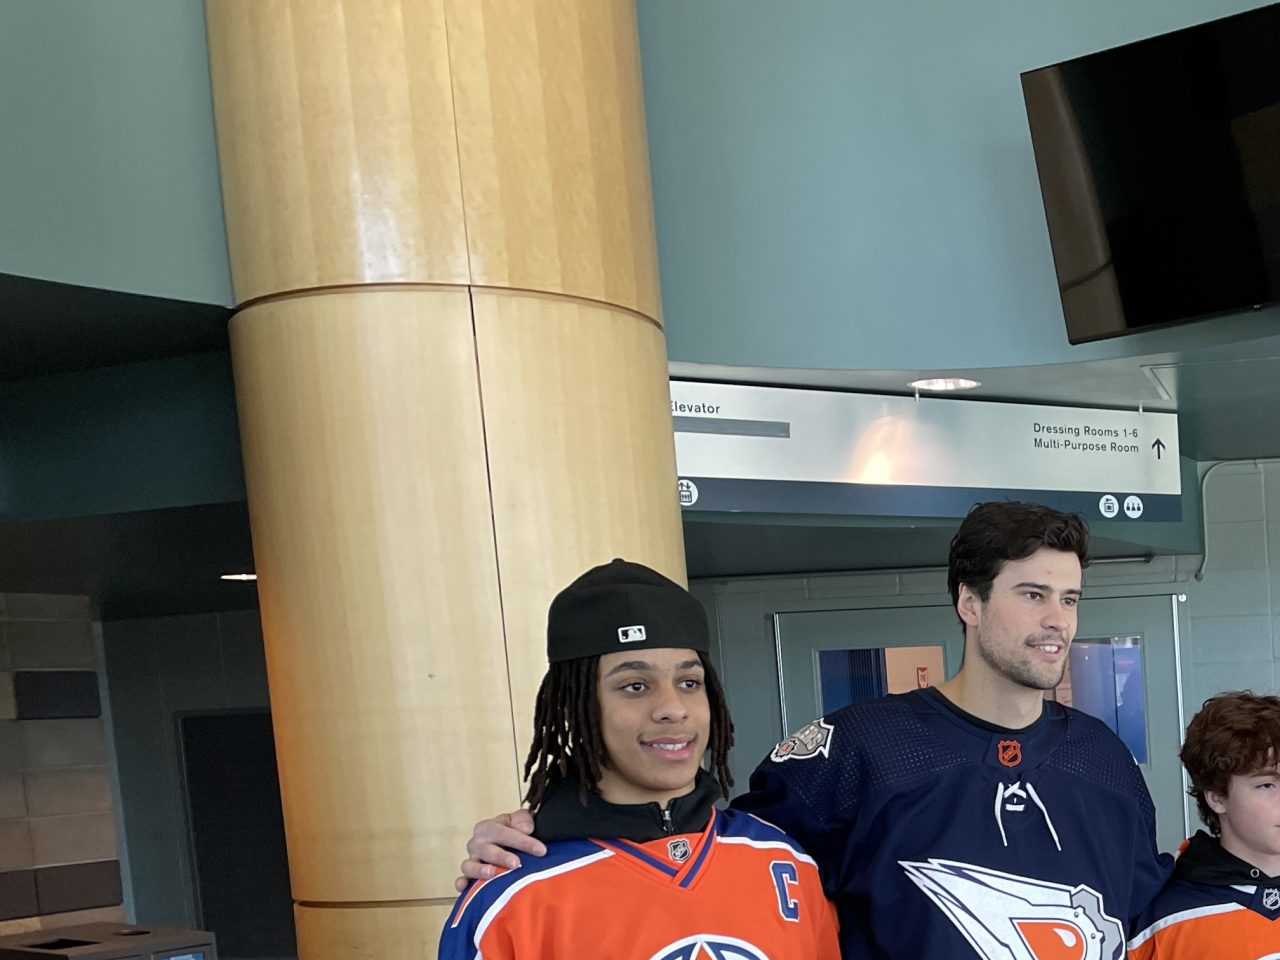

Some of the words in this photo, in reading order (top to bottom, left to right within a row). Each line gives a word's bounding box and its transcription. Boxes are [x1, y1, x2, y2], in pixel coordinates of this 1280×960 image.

[1033, 422, 1080, 437] Dressing
[1083, 425, 1119, 437] Rooms
[1123, 428, 1139, 438] 1-6
[1034, 438, 1107, 452] Multi-Purpose
[1110, 442, 1139, 453] Room
[769, 861, 799, 922] C
